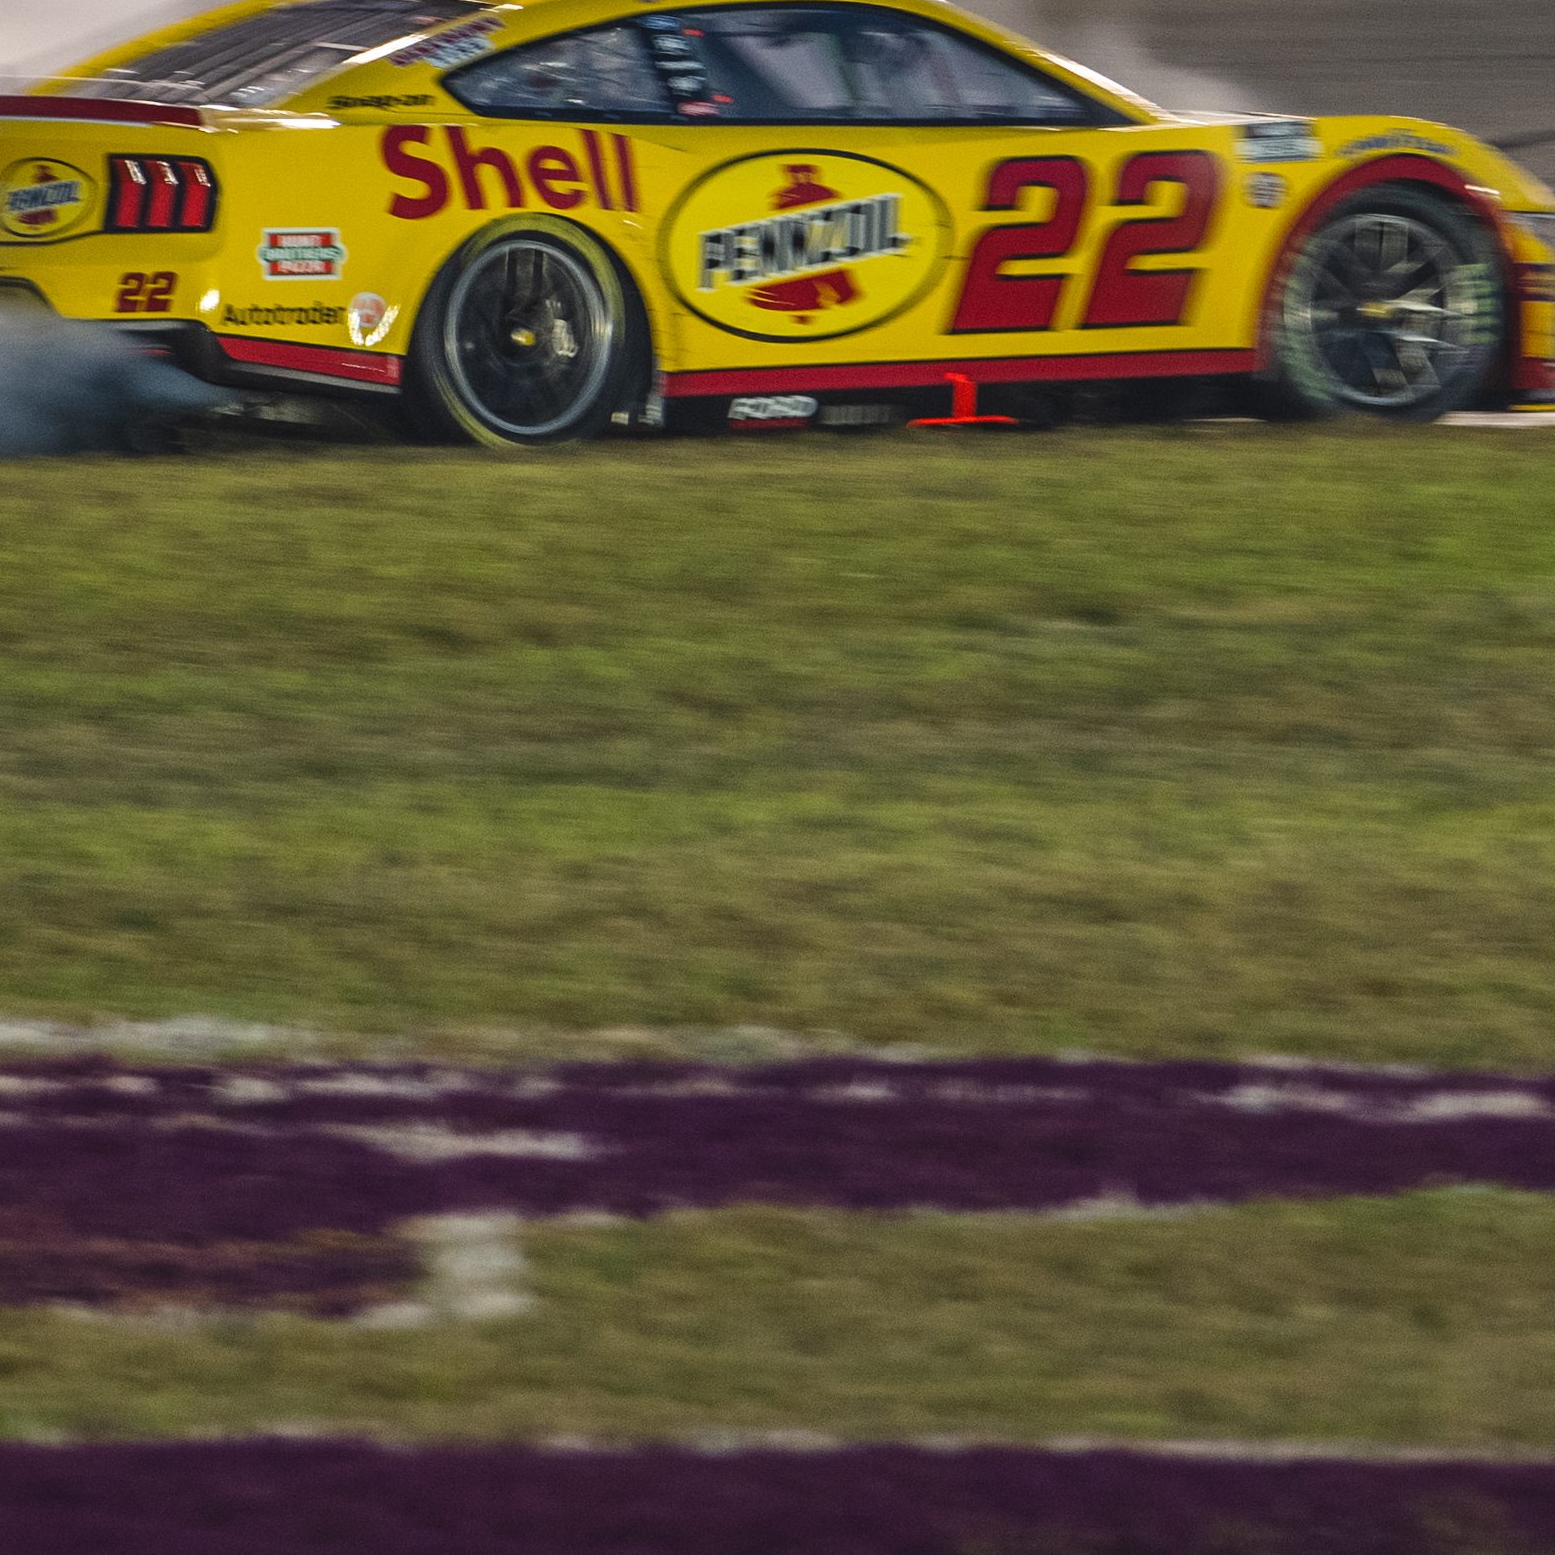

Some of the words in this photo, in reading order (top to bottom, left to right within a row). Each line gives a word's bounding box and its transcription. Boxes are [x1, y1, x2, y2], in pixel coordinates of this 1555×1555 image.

[380, 124, 640, 220] Shell
[698, 192, 912, 292] PENNZOIL
[944, 148, 1220, 334] 22
[114, 271, 178, 313] 22
